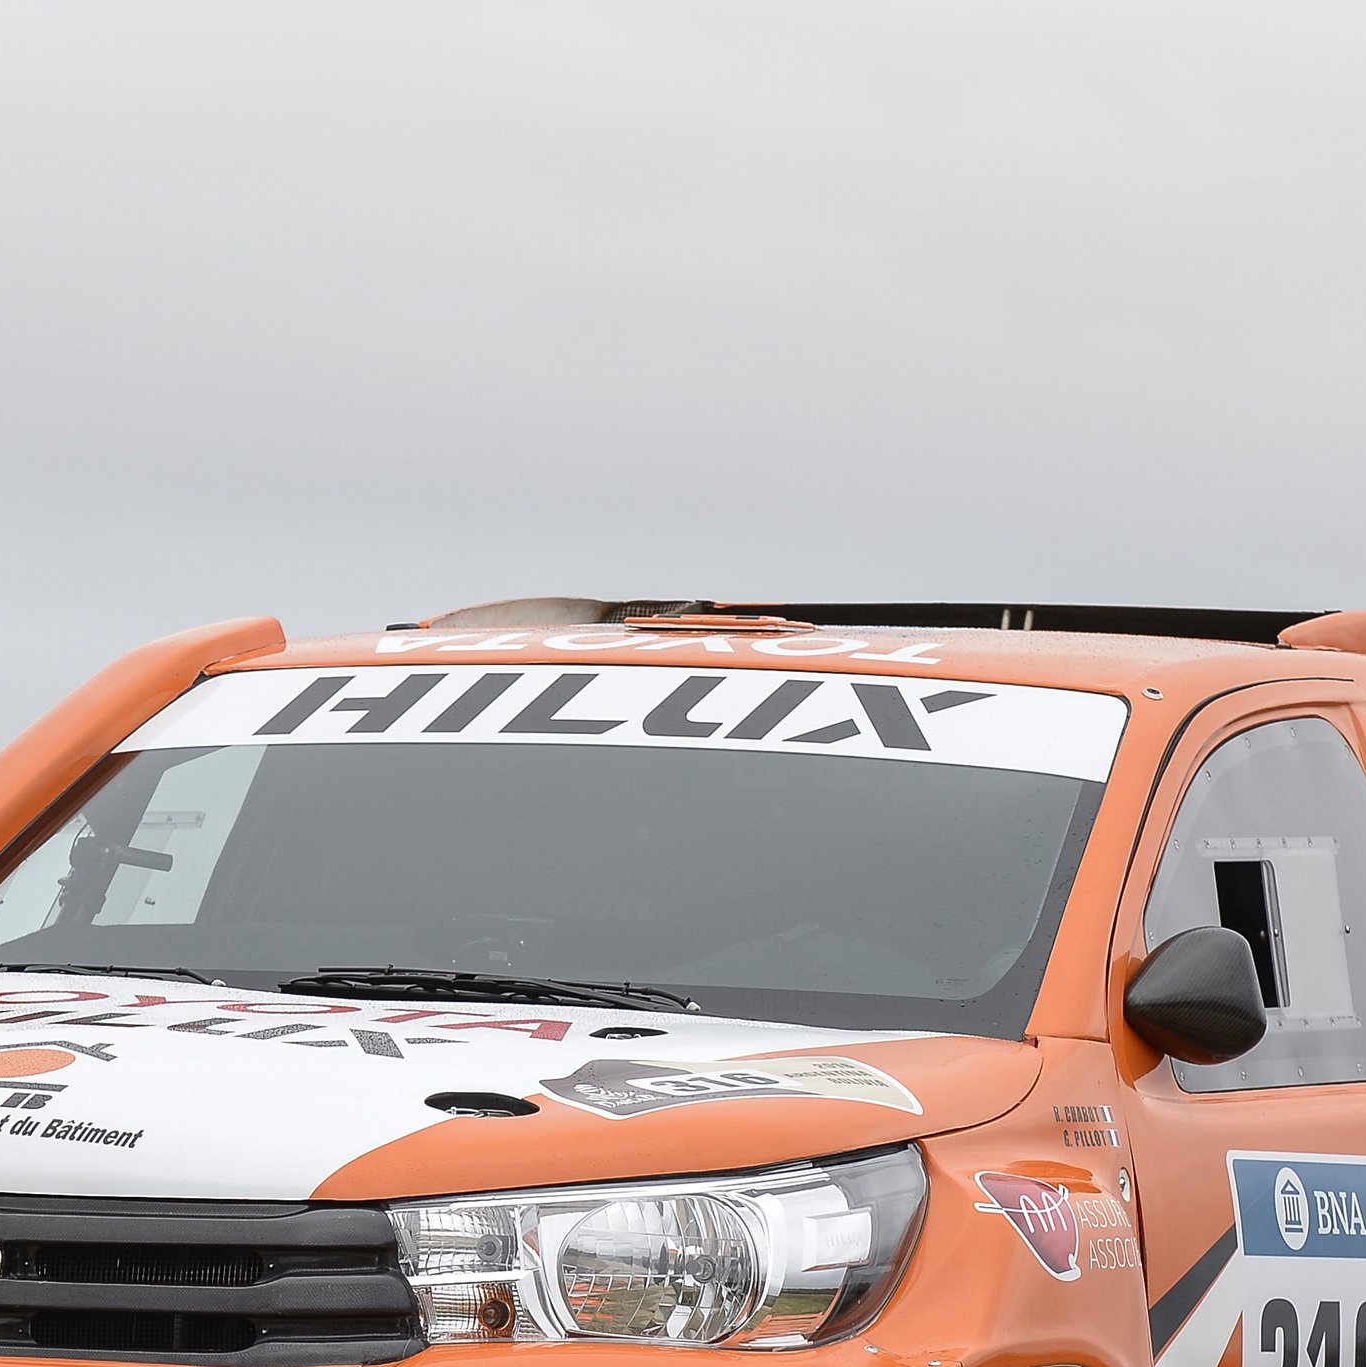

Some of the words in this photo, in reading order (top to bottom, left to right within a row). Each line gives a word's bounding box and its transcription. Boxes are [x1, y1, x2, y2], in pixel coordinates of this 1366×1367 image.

[254, 672, 998, 751] HILUX
[650, 1072, 780, 1093] 316
[10, 1115, 41, 1137] du
[40, 1118, 145, 1149] Bâtiment
[1074, 1130, 1107, 1147] PILLOT
[1314, 1191, 1366, 1236] BNA
